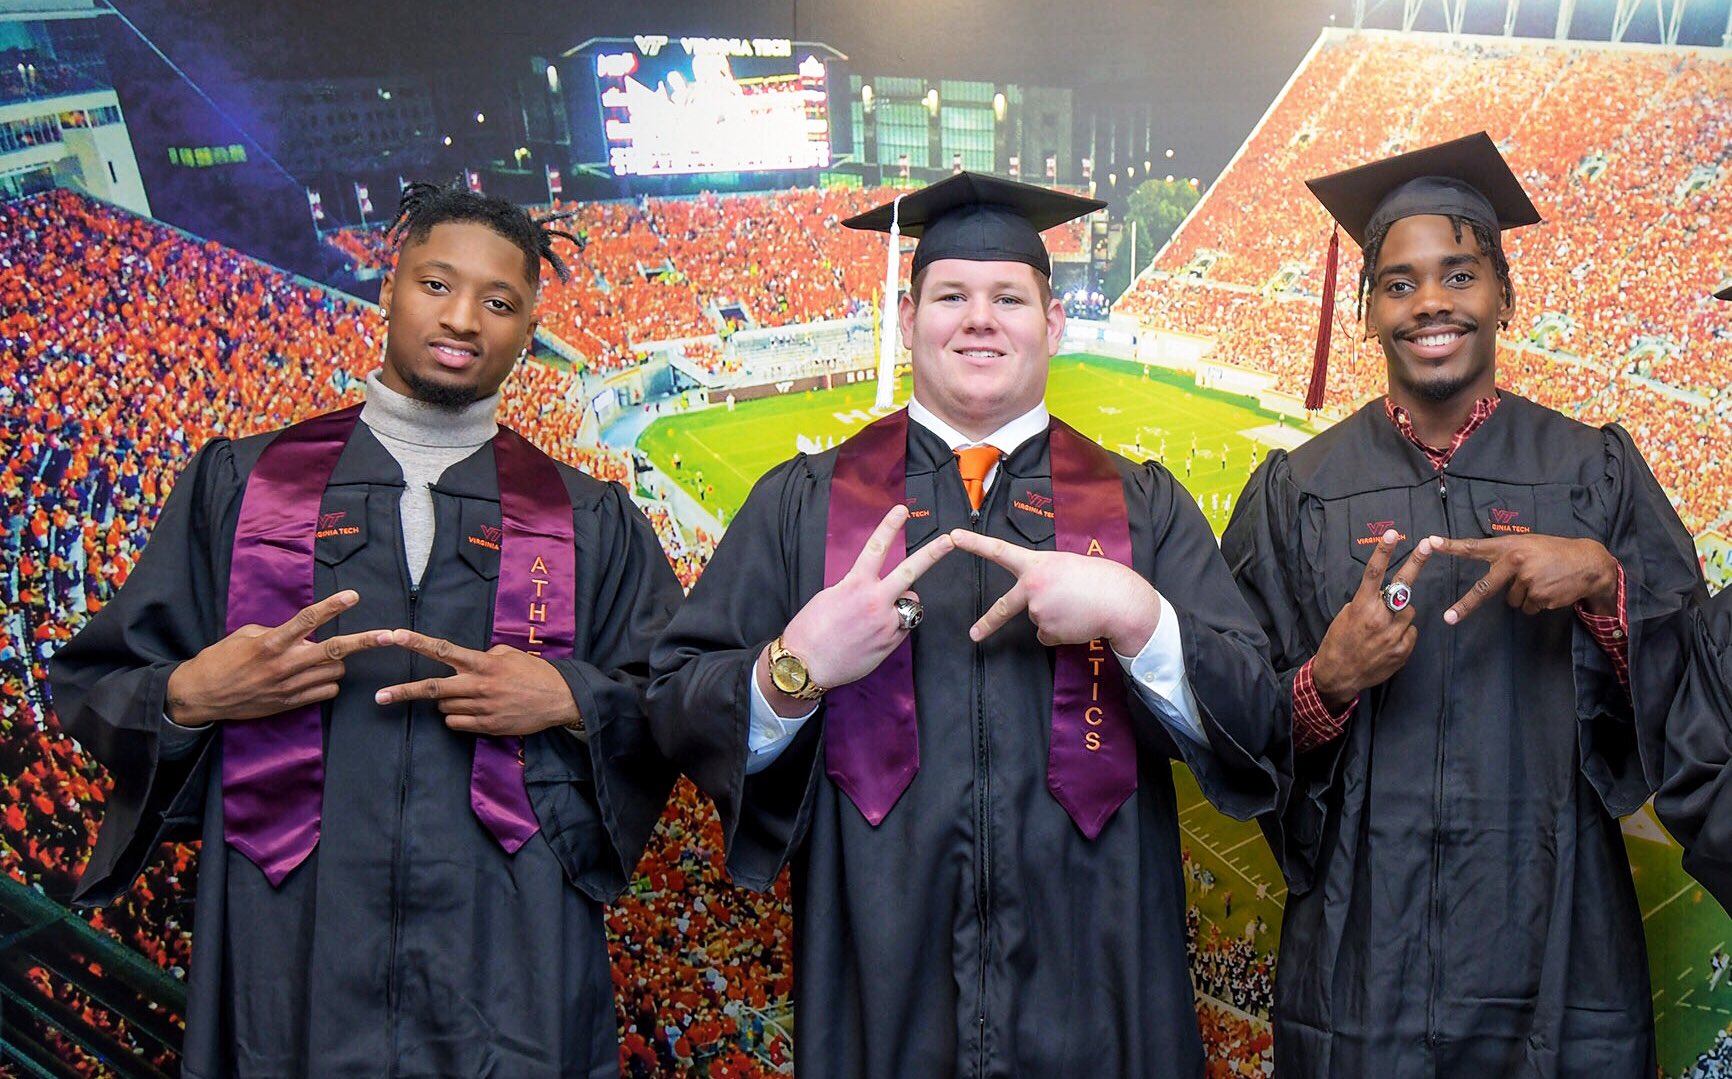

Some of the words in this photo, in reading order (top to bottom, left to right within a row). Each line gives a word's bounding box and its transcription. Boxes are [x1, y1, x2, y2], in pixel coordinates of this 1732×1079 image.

[634, 35, 668, 56] VT
[752, 38, 792, 57] TECH
[1026, 491, 1053, 508] VT
[911, 510, 930, 518] TECH
[1013, 500, 1043, 516] VIRGINIA
[1043, 510, 1055, 518] TEC
[1491, 508, 1519, 524] VT
[316, 529, 338, 538] GINIA
[338, 527, 360, 535] TECH
[1367, 521, 1395, 536] VT
[1491, 523, 1511, 532] GINIA
[1512, 525, 1530, 533] TECH
[468, 536, 500, 550] VIRGINIA
[1084, 538, 1105, 752] AETICS
